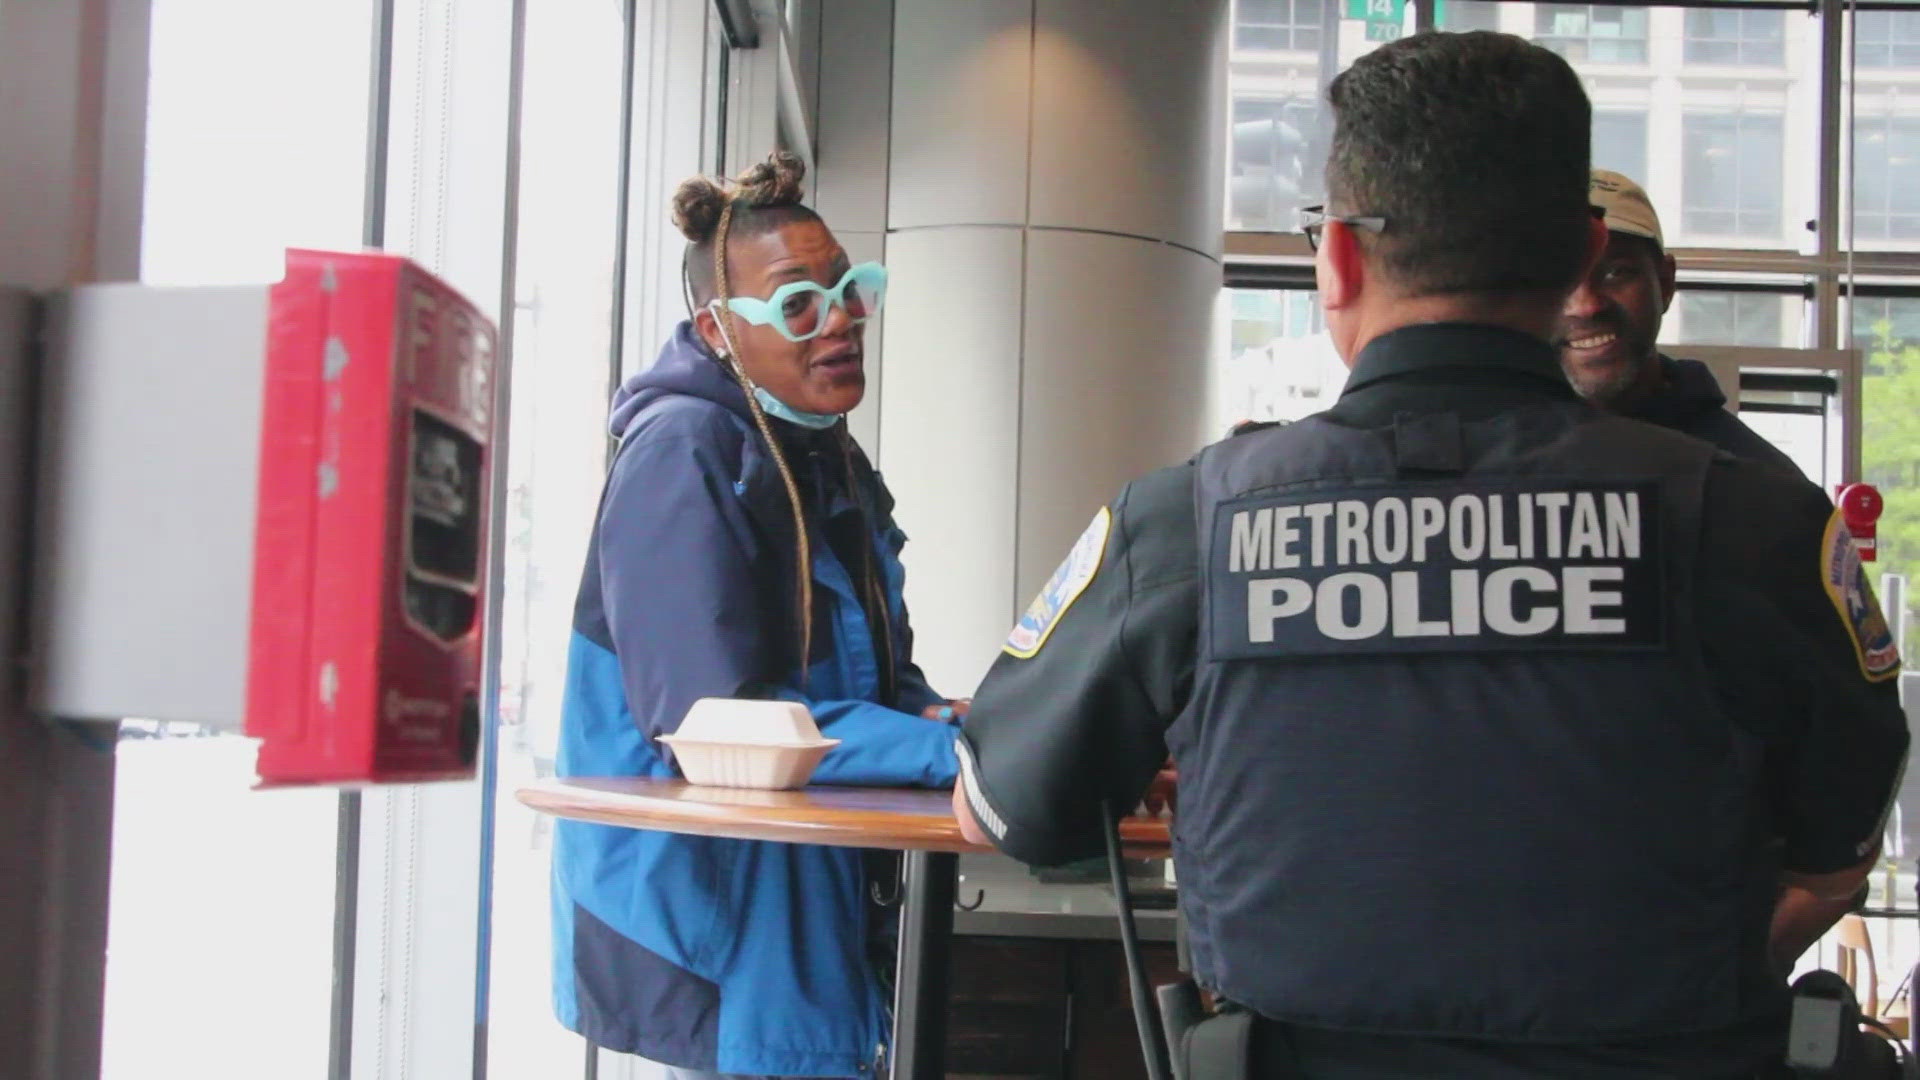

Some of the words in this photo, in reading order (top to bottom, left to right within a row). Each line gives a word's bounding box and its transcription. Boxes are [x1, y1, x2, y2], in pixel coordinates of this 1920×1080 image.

[1367, 0, 1395, 16] 14
[1229, 492, 1641, 572] METROPOLITAN
[1248, 566, 1627, 643] POLICE
